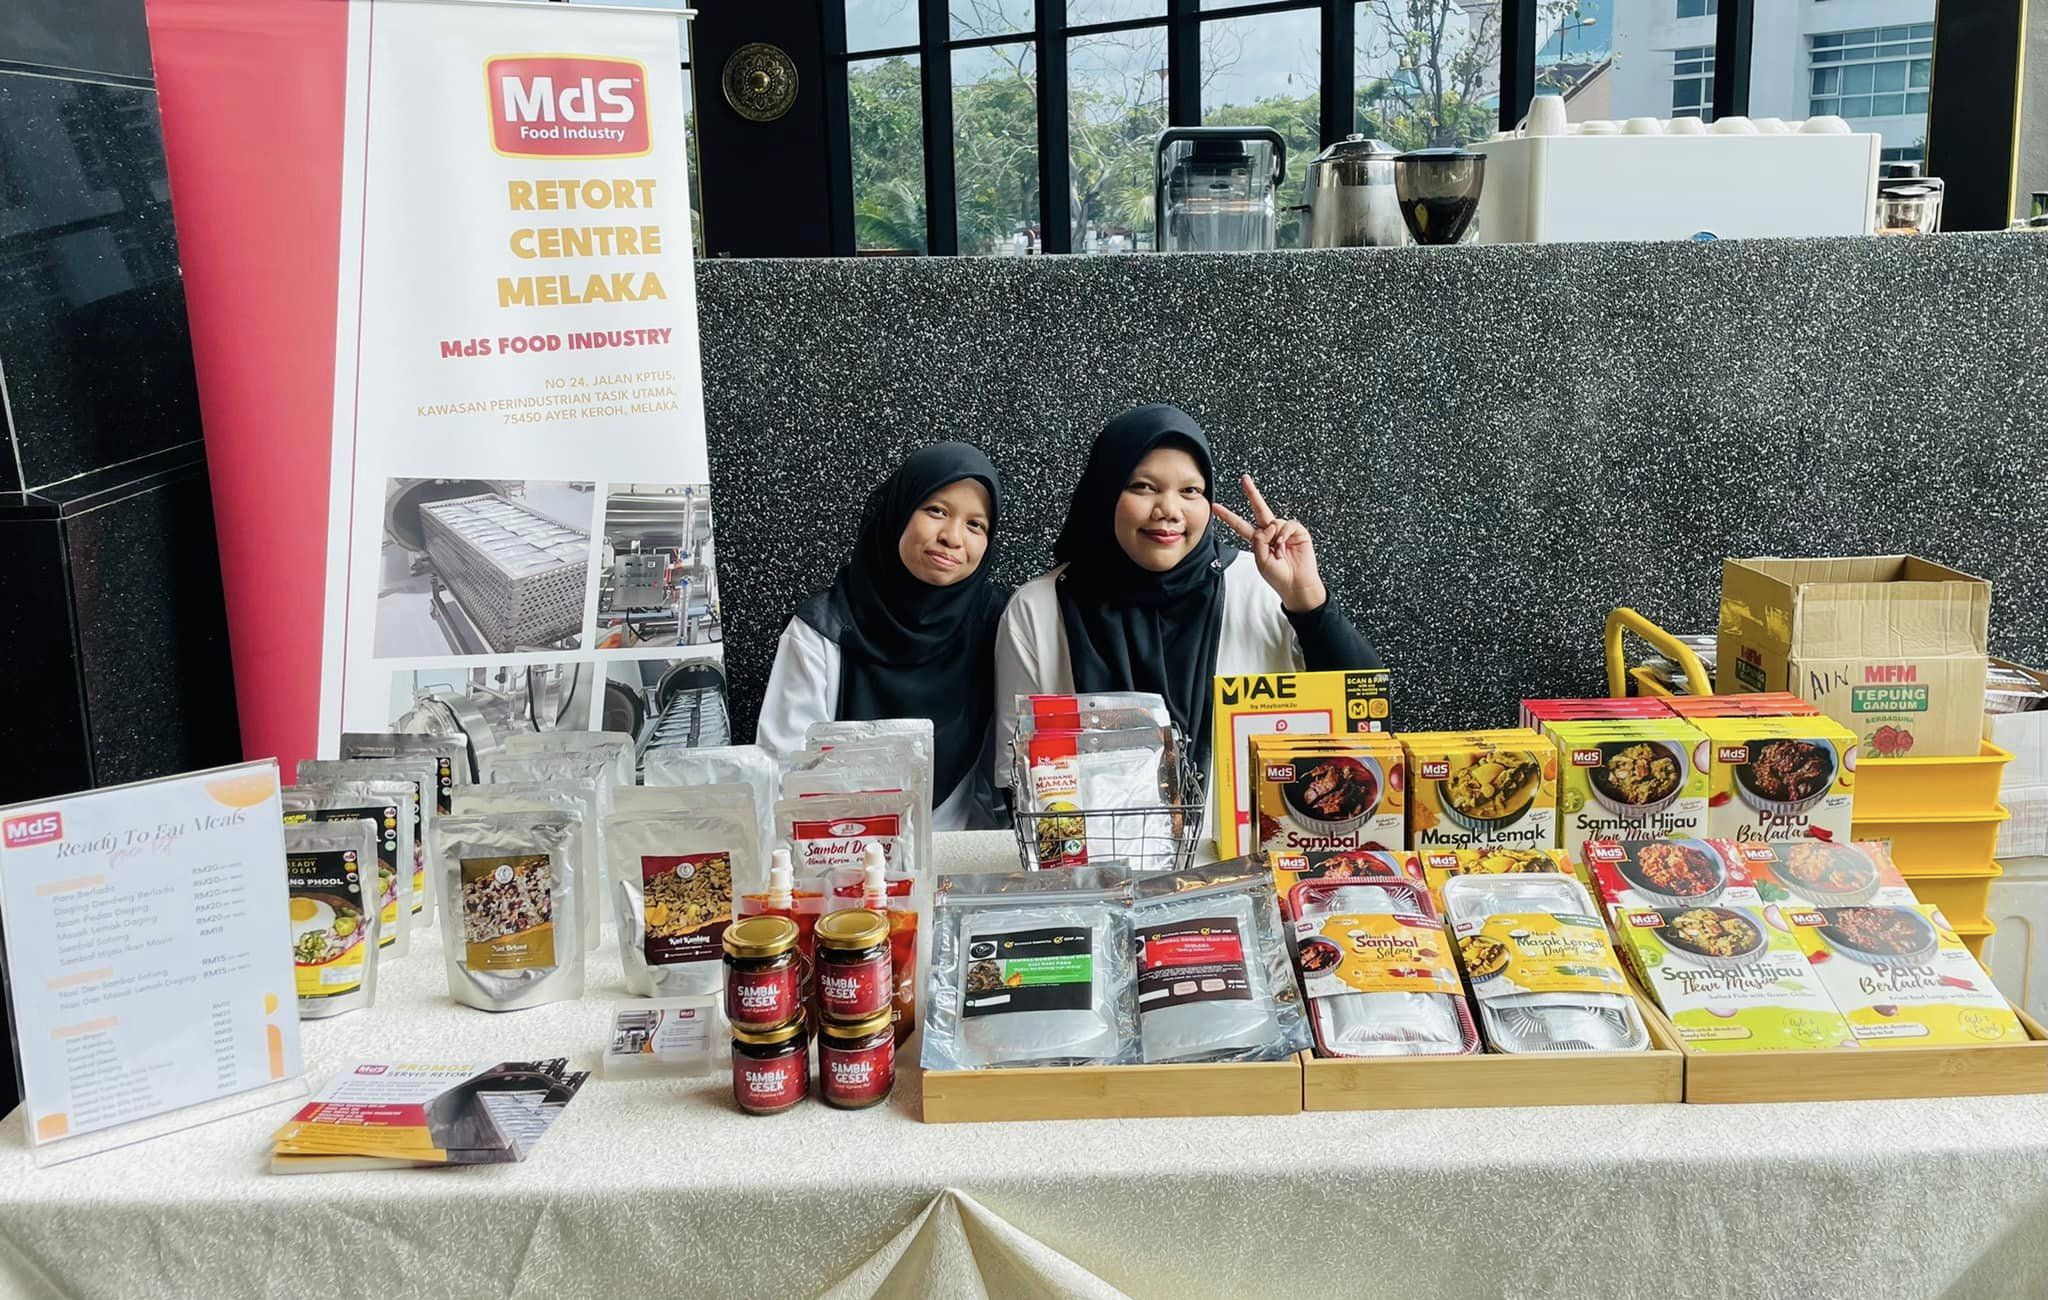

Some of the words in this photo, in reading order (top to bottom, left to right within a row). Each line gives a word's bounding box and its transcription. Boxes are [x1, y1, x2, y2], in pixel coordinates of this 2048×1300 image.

[502, 76, 635, 123] MdS
[520, 126, 559, 139] Food
[563, 127, 625, 142] Industry
[508, 178, 656, 211] RETORT
[509, 225, 661, 259] CENTRE
[496, 271, 667, 307] MELAKA
[440, 337, 491, 358] MdS
[499, 333, 561, 355] FOOD
[568, 327, 672, 350] INDUSTRY
[545, 378, 567, 390] NO
[592, 373, 634, 387] JALAN
[417, 401, 487, 417] KAWASAN
[490, 394, 591, 412] PERINDUSTRIAN
[594, 390, 629, 403] TASIK
[632, 387, 677, 400] UTAMA,
[503, 412, 542, 425] 75450
[545, 409, 577, 421] AYER
[630, 400, 679, 414] MELAKA
[1865, 665, 1916, 683] MFM
[1855, 688, 1925, 700] TEPUNG
[1863, 701, 1917, 710] GANDUM
[1574, 752, 1599, 763] MdS
[1720, 749, 1746, 759] MdS
[1267, 767, 1293, 777] MdS
[1423, 765, 1448, 775] MdS
[1036, 779, 1077, 788] MAMAN
[1577, 813, 1647, 832] Sambal
[1651, 813, 1697, 837] Hijau
[1758, 810, 1808, 827] Paru
[7, 816, 58, 840] MdS
[57, 832, 117, 859] Ready
[124, 828, 149, 846] To
[155, 823, 184, 841] Eat
[193, 809, 245, 832] Meals
[1421, 828, 1482, 845] Masak
[1487, 824, 1546, 842] Lemak
[1736, 822, 1801, 843] Berlada
[1287, 831, 1359, 849] Sambal
[804, 840, 850, 857] Sambal
[1596, 848, 1623, 857] MdS
[1747, 849, 1773, 858] MdS
[1279, 858, 1305, 867] MdS
[1430, 856, 1457, 866] MdS
[307, 877, 344, 885] PHOOL
[1630, 914, 1660, 923] MdS
[1793, 914, 1821, 923] MdS
[1356, 935, 1418, 948] Sambal
[1516, 936, 1560, 948] Masak
[1564, 936, 1606, 950] Lemak
[1661, 964, 1744, 981] Sambal
[1750, 963, 1803, 981] Hijau
[1872, 962, 1934, 978] Paru
[821, 974, 861, 988] SAMBAL
[1859, 973, 1936, 995] Berlada
[738, 983, 781, 997] SAMBAL
[824, 987, 856, 999] GESEK
[742, 996, 776, 1008] GESEK
[831, 1060, 873, 1074] SAMBAL
[746, 1069, 788, 1083] SAMBAL
[836, 1072, 870, 1084] GESEK
[750, 1081, 785, 1093] GESEK
